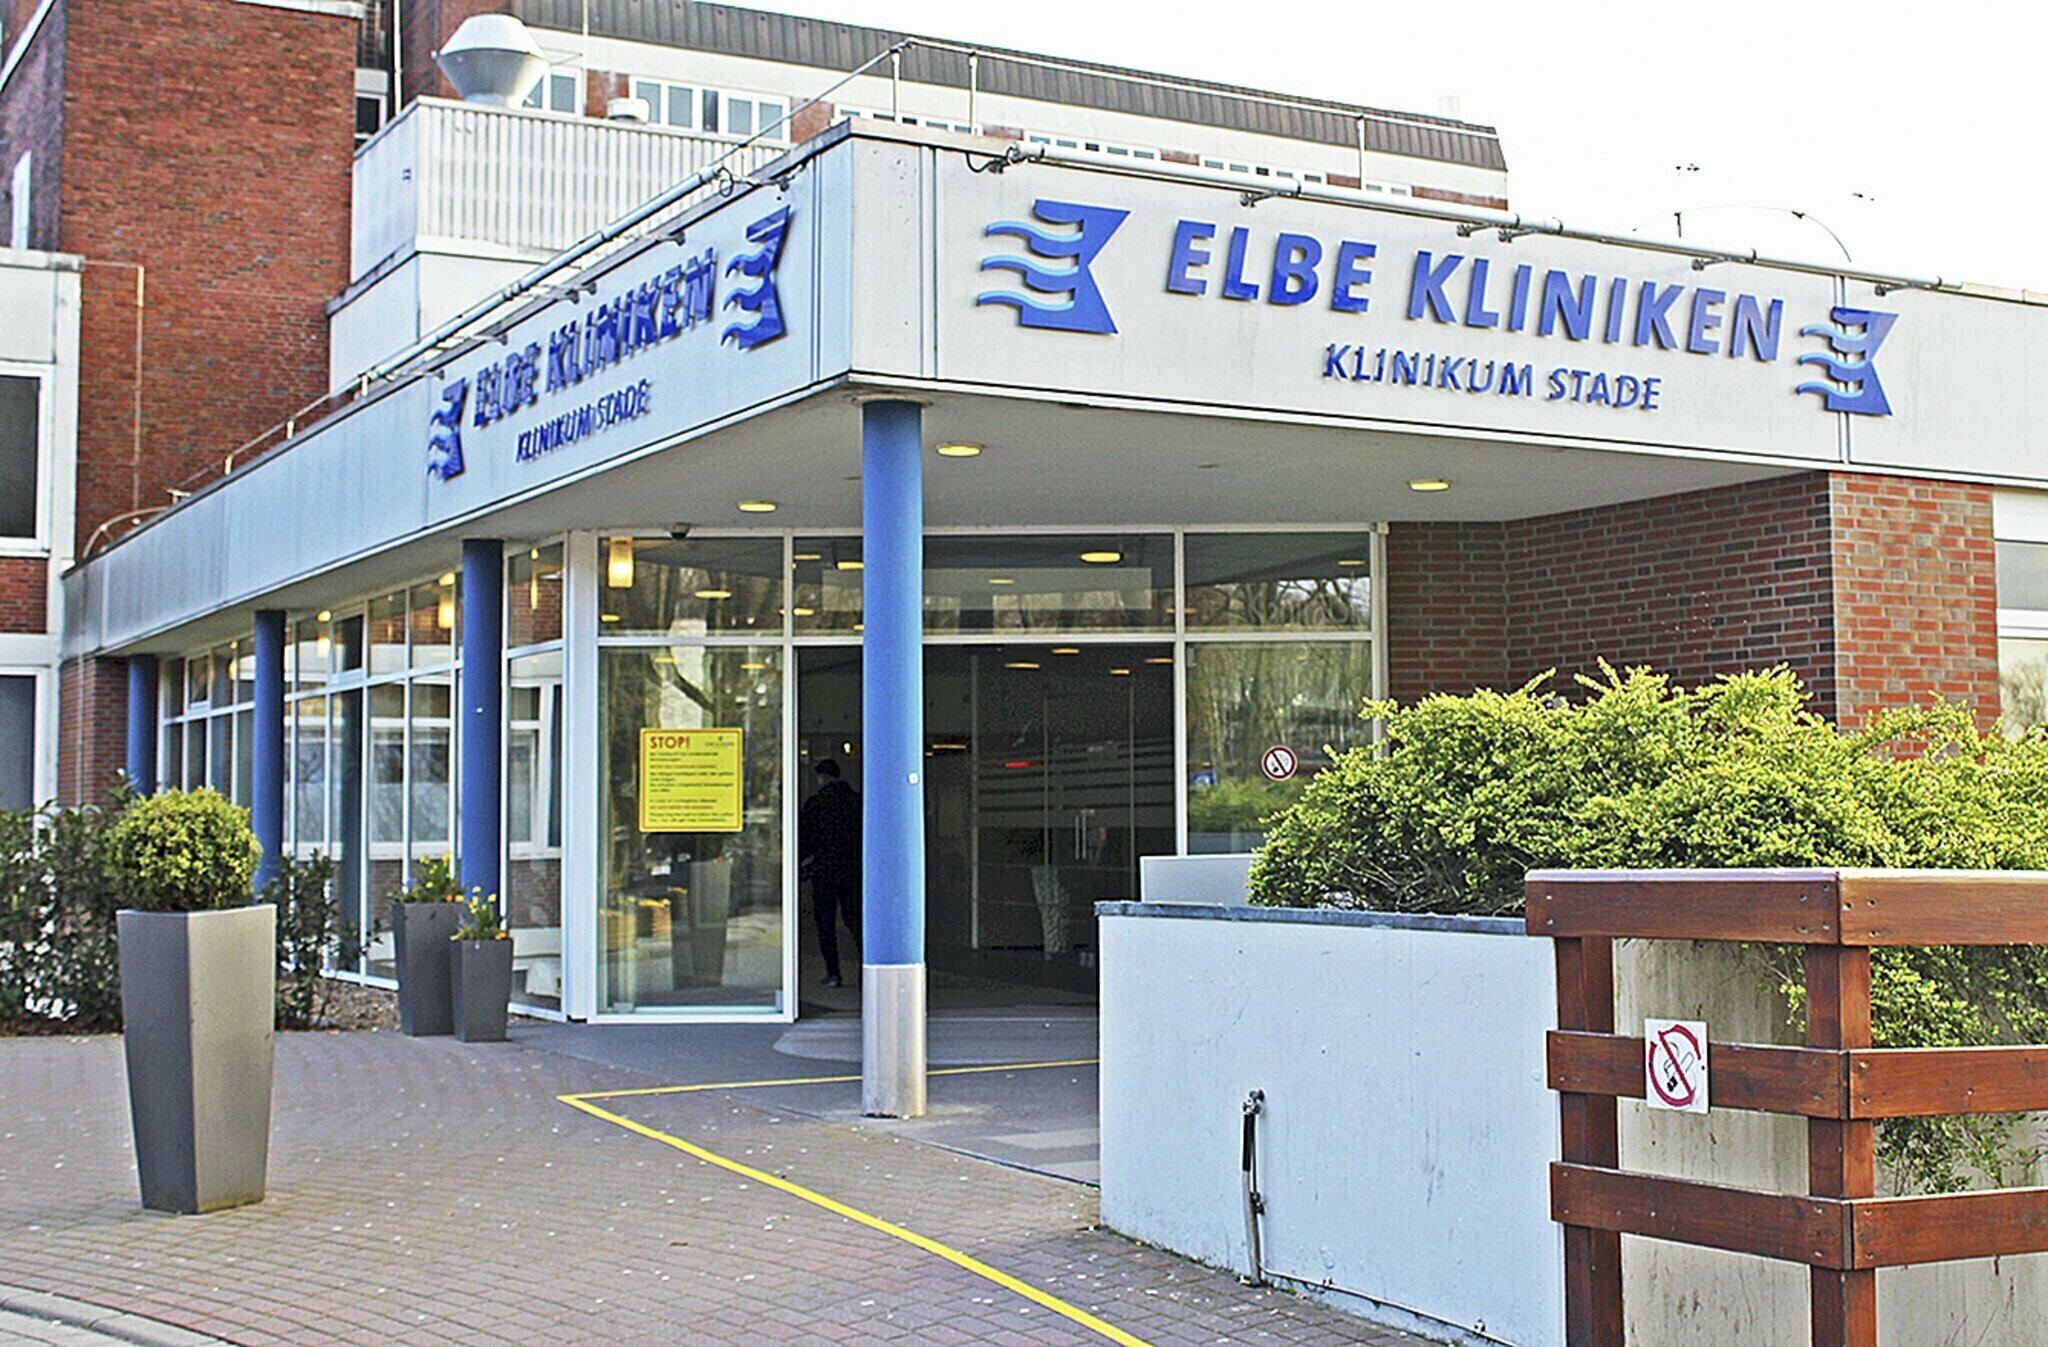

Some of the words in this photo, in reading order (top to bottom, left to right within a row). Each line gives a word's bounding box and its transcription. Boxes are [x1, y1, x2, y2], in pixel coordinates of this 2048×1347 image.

[1167, 218, 1378, 312] ELBE
[1408, 250, 1785, 361] KLINIKEN
[473, 341, 542, 427] ELBE
[544, 245, 719, 394] KLINIKEN
[1325, 342, 1534, 397] KLINIKUM
[1550, 366, 1662, 410] STADE
[515, 402, 595, 464] KLINIKUM
[597, 377, 653, 432] STADE
[649, 736, 691, 749] STOP!
